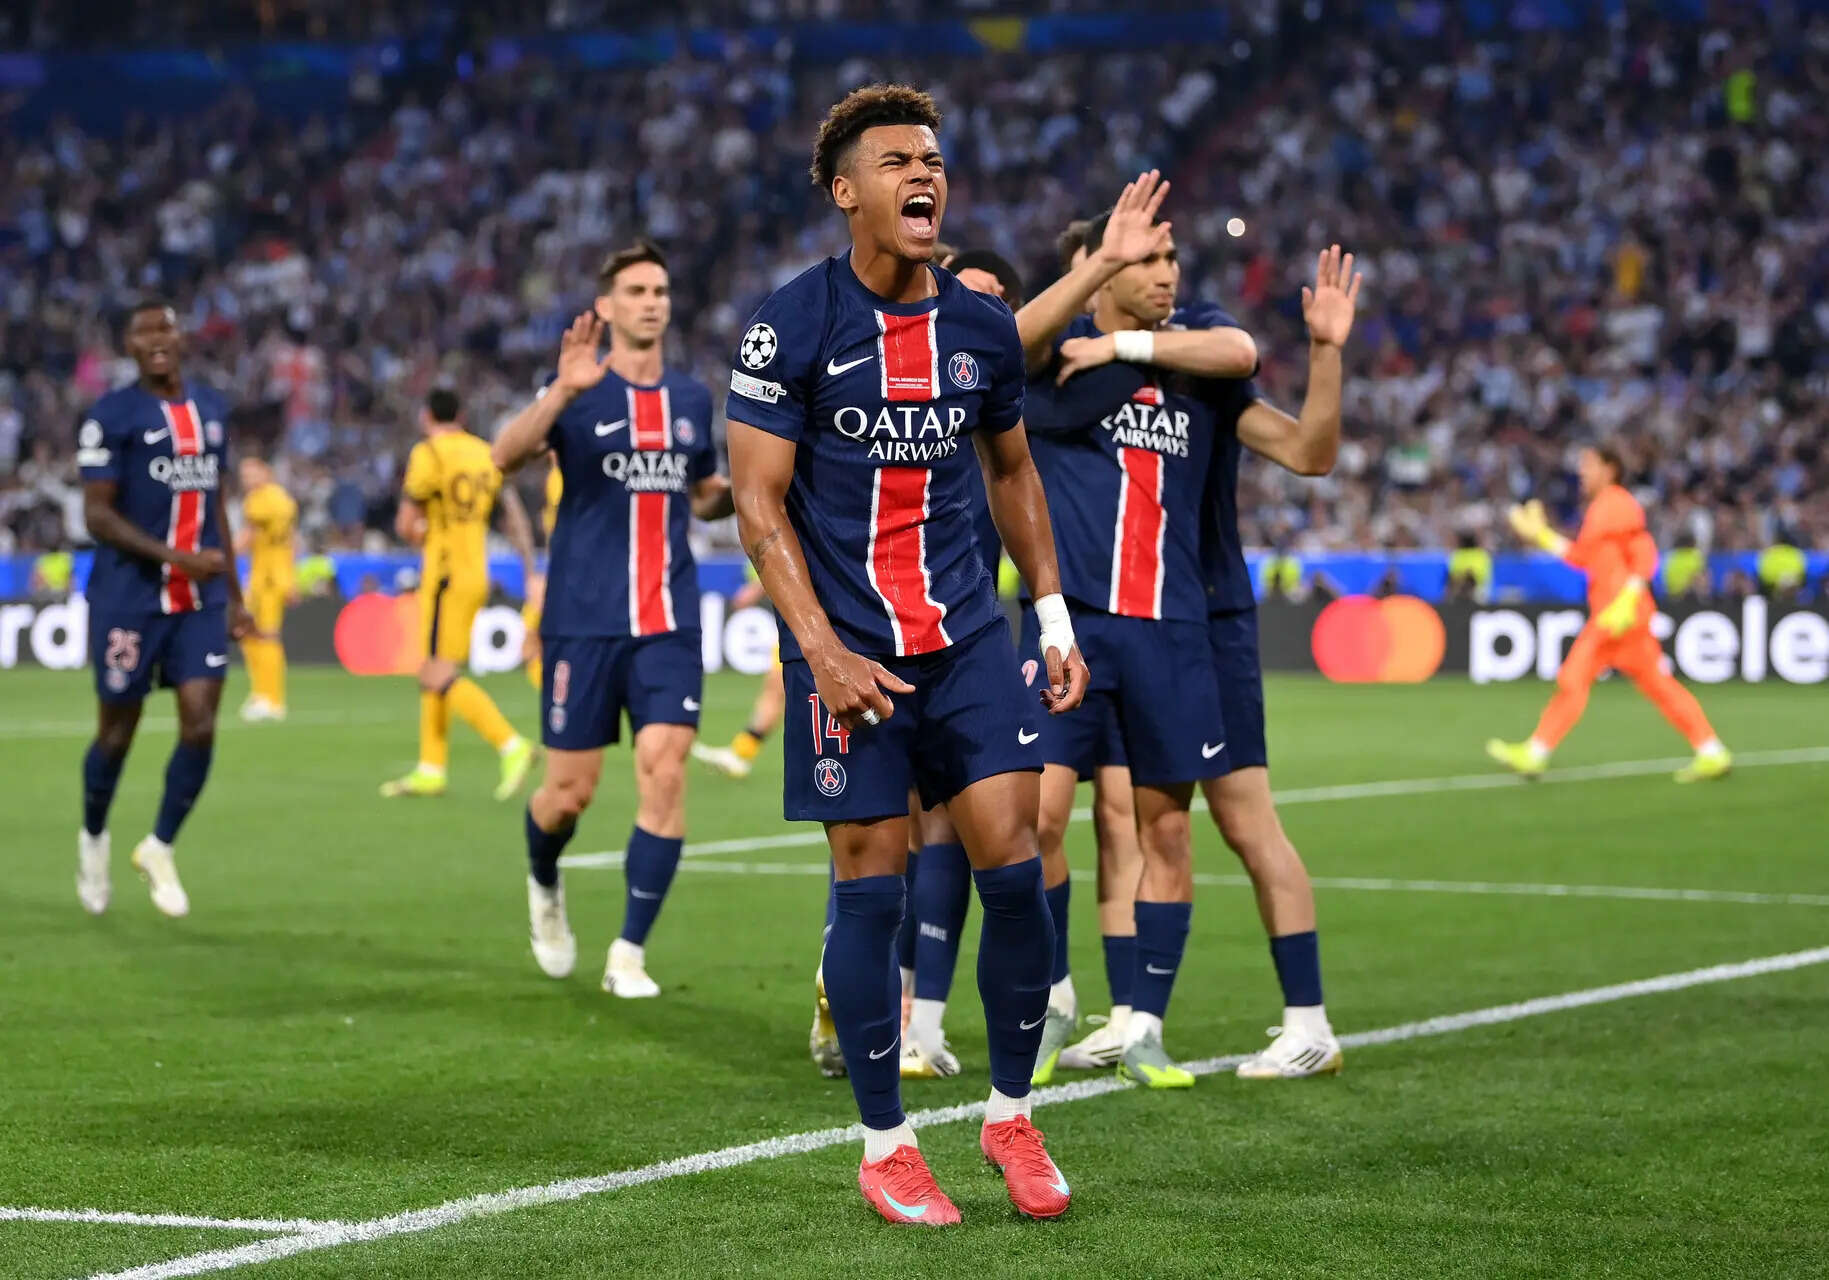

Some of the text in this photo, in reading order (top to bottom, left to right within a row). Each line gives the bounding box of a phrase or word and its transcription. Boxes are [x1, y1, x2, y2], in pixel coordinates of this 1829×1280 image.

[833, 406, 966, 443] QATAR
[867, 436, 958, 462] AIRWAYS
[1112, 425, 1189, 458] AIRWAYS
[602, 451, 689, 482] QATAR
[808, 693, 851, 756] 14
[817, 760, 839, 771] PARIS
